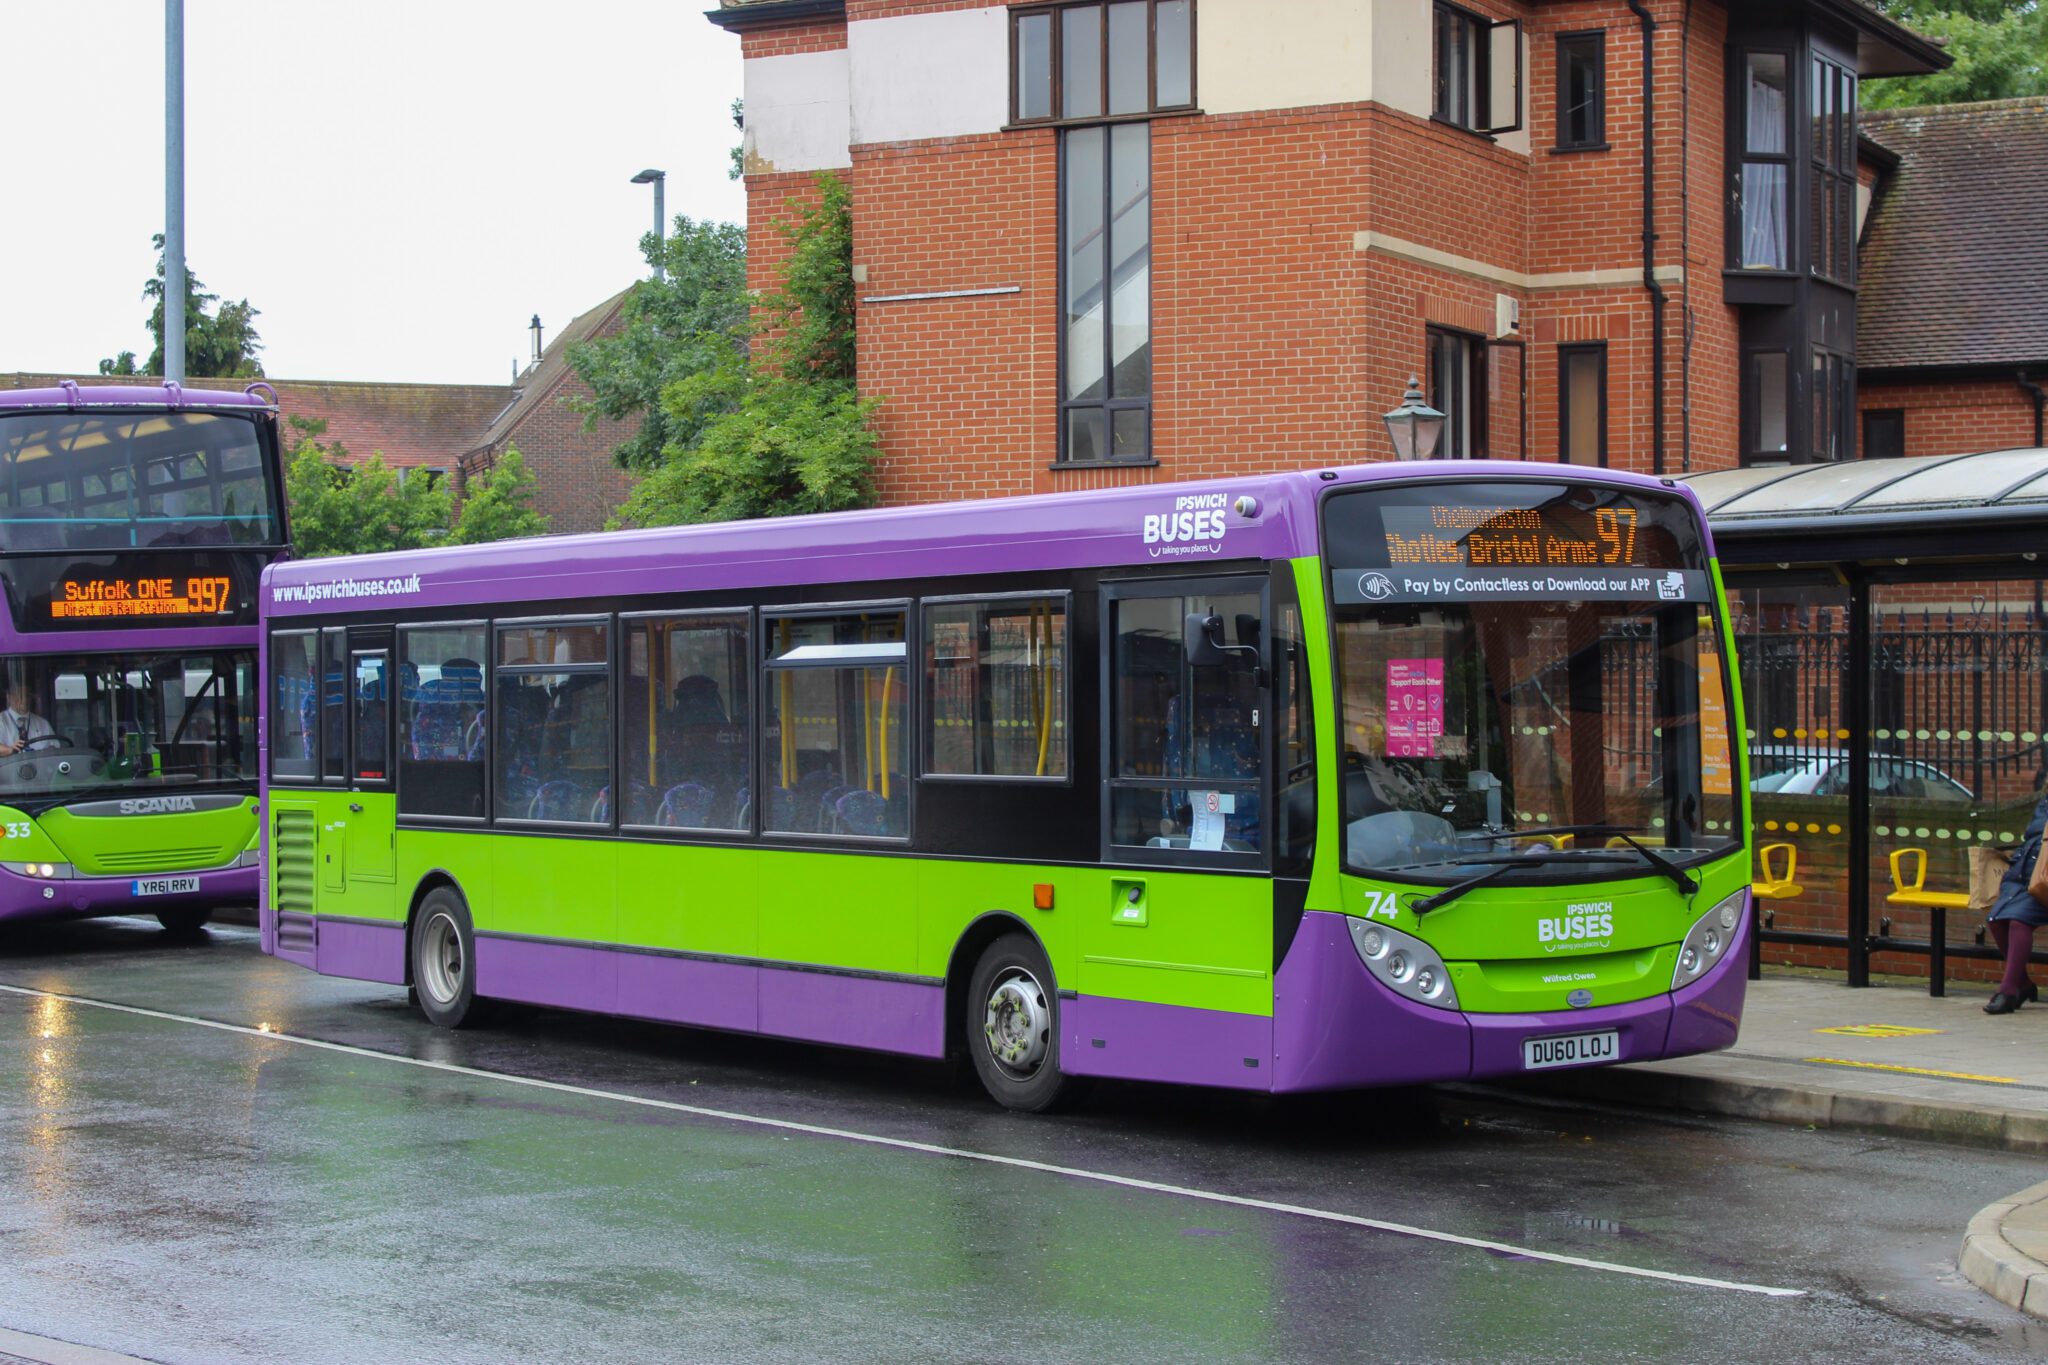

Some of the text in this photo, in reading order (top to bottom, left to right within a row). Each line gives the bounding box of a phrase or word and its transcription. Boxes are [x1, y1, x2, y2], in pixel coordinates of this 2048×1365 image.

[1175, 493, 1228, 510] IPSWICH
[1143, 509, 1226, 544] BUSES
[1595, 507, 1638, 564] 97
[1162, 544, 1209, 556] taking you places
[1468, 534, 1541, 564] Bristol
[1545, 535, 1599, 564] Arms
[64, 578, 173, 601] Suffolk ONE
[186, 577, 230, 613] 997
[273, 573, 422, 604] www.ipswichbuses.co.uk
[1403, 577, 1651, 596] Pay by Contactless or Download our APP
[63, 600, 178, 616] Direct via Rail Station
[1391, 678, 1441, 688] Support Each Other
[119, 796, 196, 814] SCANIA
[6, 822, 31, 839] 33
[142, 878, 195, 894] YR61 RRV
[1364, 891, 1399, 920] 74
[1567, 901, 1613, 915] IPSWICH
[1538, 914, 1614, 942] BUSES
[1557, 941, 1599, 951] taking you places
[1542, 972, 1597, 984] Wilfred Owen
[1532, 1035, 1612, 1064] DU60 LOJ
